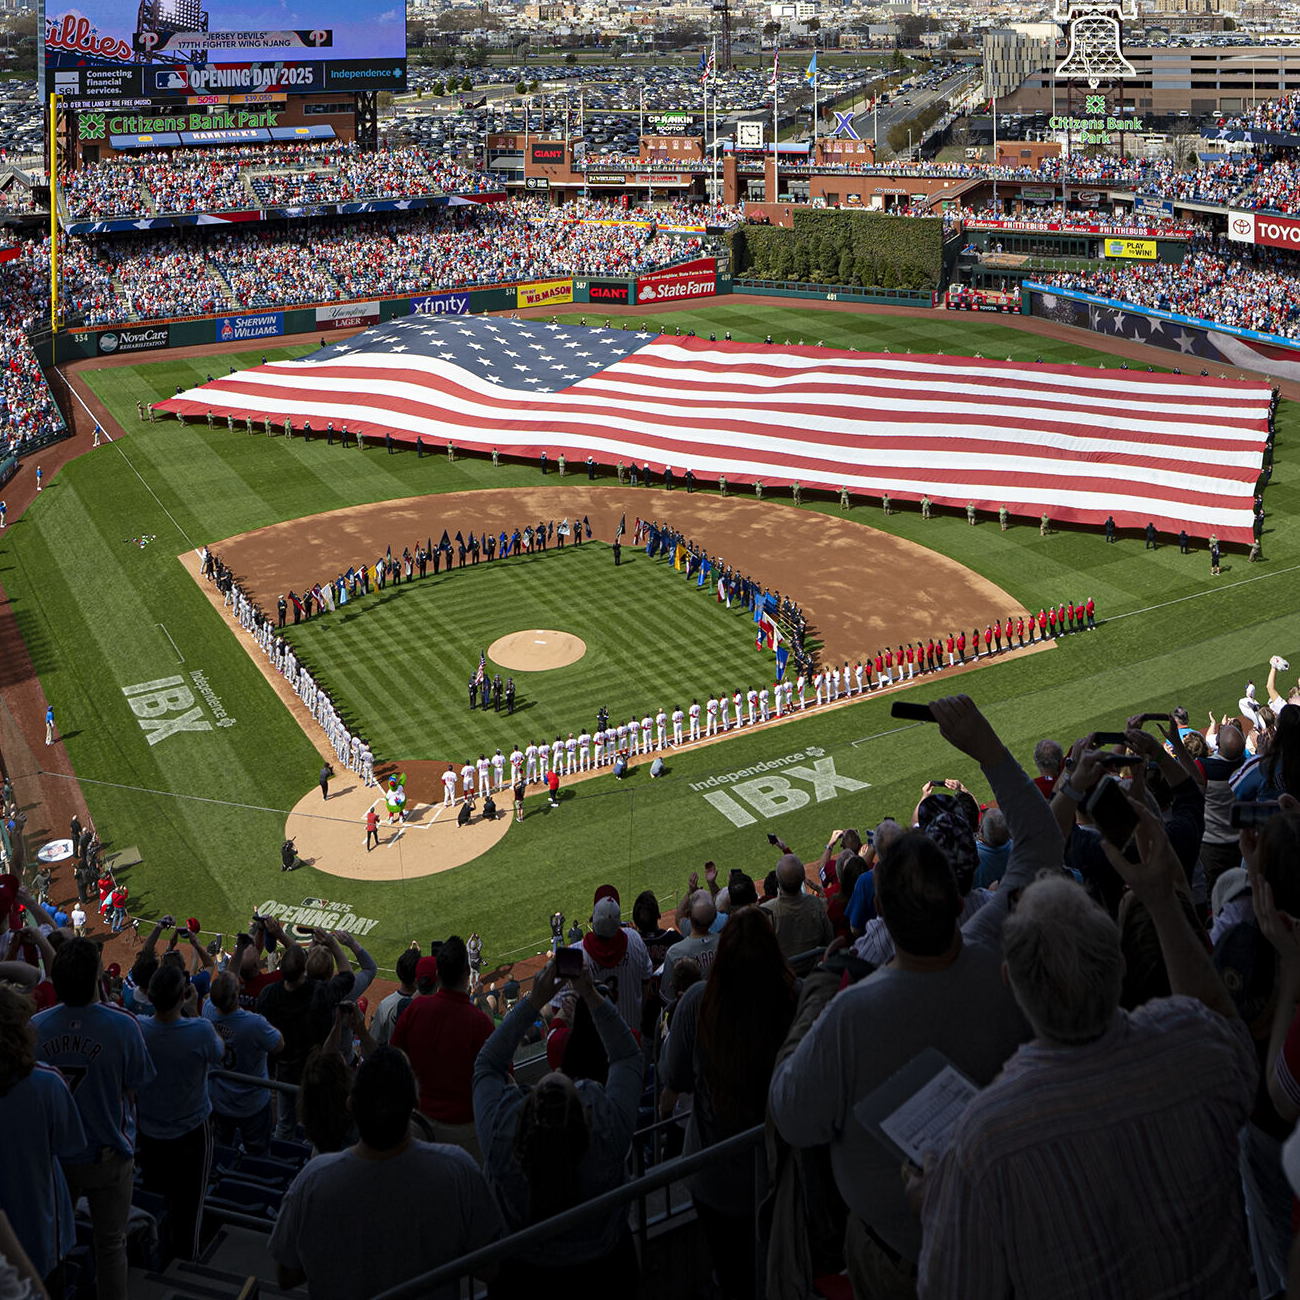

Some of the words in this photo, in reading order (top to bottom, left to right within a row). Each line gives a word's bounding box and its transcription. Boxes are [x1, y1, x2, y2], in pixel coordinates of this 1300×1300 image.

[45, 14, 132, 60] illies
[178, 41, 200, 49] 177TH
[203, 40, 236, 48] FIGHTER
[238, 40, 261, 48] WING
[262, 39, 291, 47] NJANG
[86, 70, 132, 79] Connecting
[190, 69, 252, 88] OPENING
[253, 68, 280, 86] DAY
[280, 67, 313, 85] 2025
[331, 69, 391, 79] Independence
[86, 78, 121, 86] financial
[86, 87, 122, 95] services.
[109, 114, 186, 134] Citizens
[189, 111, 234, 130] Bank
[238, 109, 278, 128] Park
[1049, 116, 1104, 130] Citizens
[1106, 117, 1142, 130] Bank
[192, 132, 227, 140] HARRY
[241, 130, 258, 138] K'S
[1080, 131, 1111, 144] Park
[534, 150, 562, 158] GIANT
[590, 287, 628, 299] GIANT
[328, 304, 368, 319] Yuengling
[414, 296, 466, 315] xfinity
[235, 316, 277, 328] SHERWIN
[335, 318, 361, 327] LAGER
[118, 329, 168, 344] NovaCare
[234, 326, 278, 338] WILLIAMS.
[119, 340, 166, 350] REHABILITATION
[189, 669, 228, 719] Independence
[121, 674, 214, 746] IBX
[688, 751, 806, 792] Independence
[702, 755, 872, 828] IBX
[326, 901, 354, 912] 2025
[258, 899, 340, 930] OPENING
[335, 912, 380, 936] DAY
[42, 1034, 102, 1061] TURNER
[56, 1064, 89, 1095] 7
